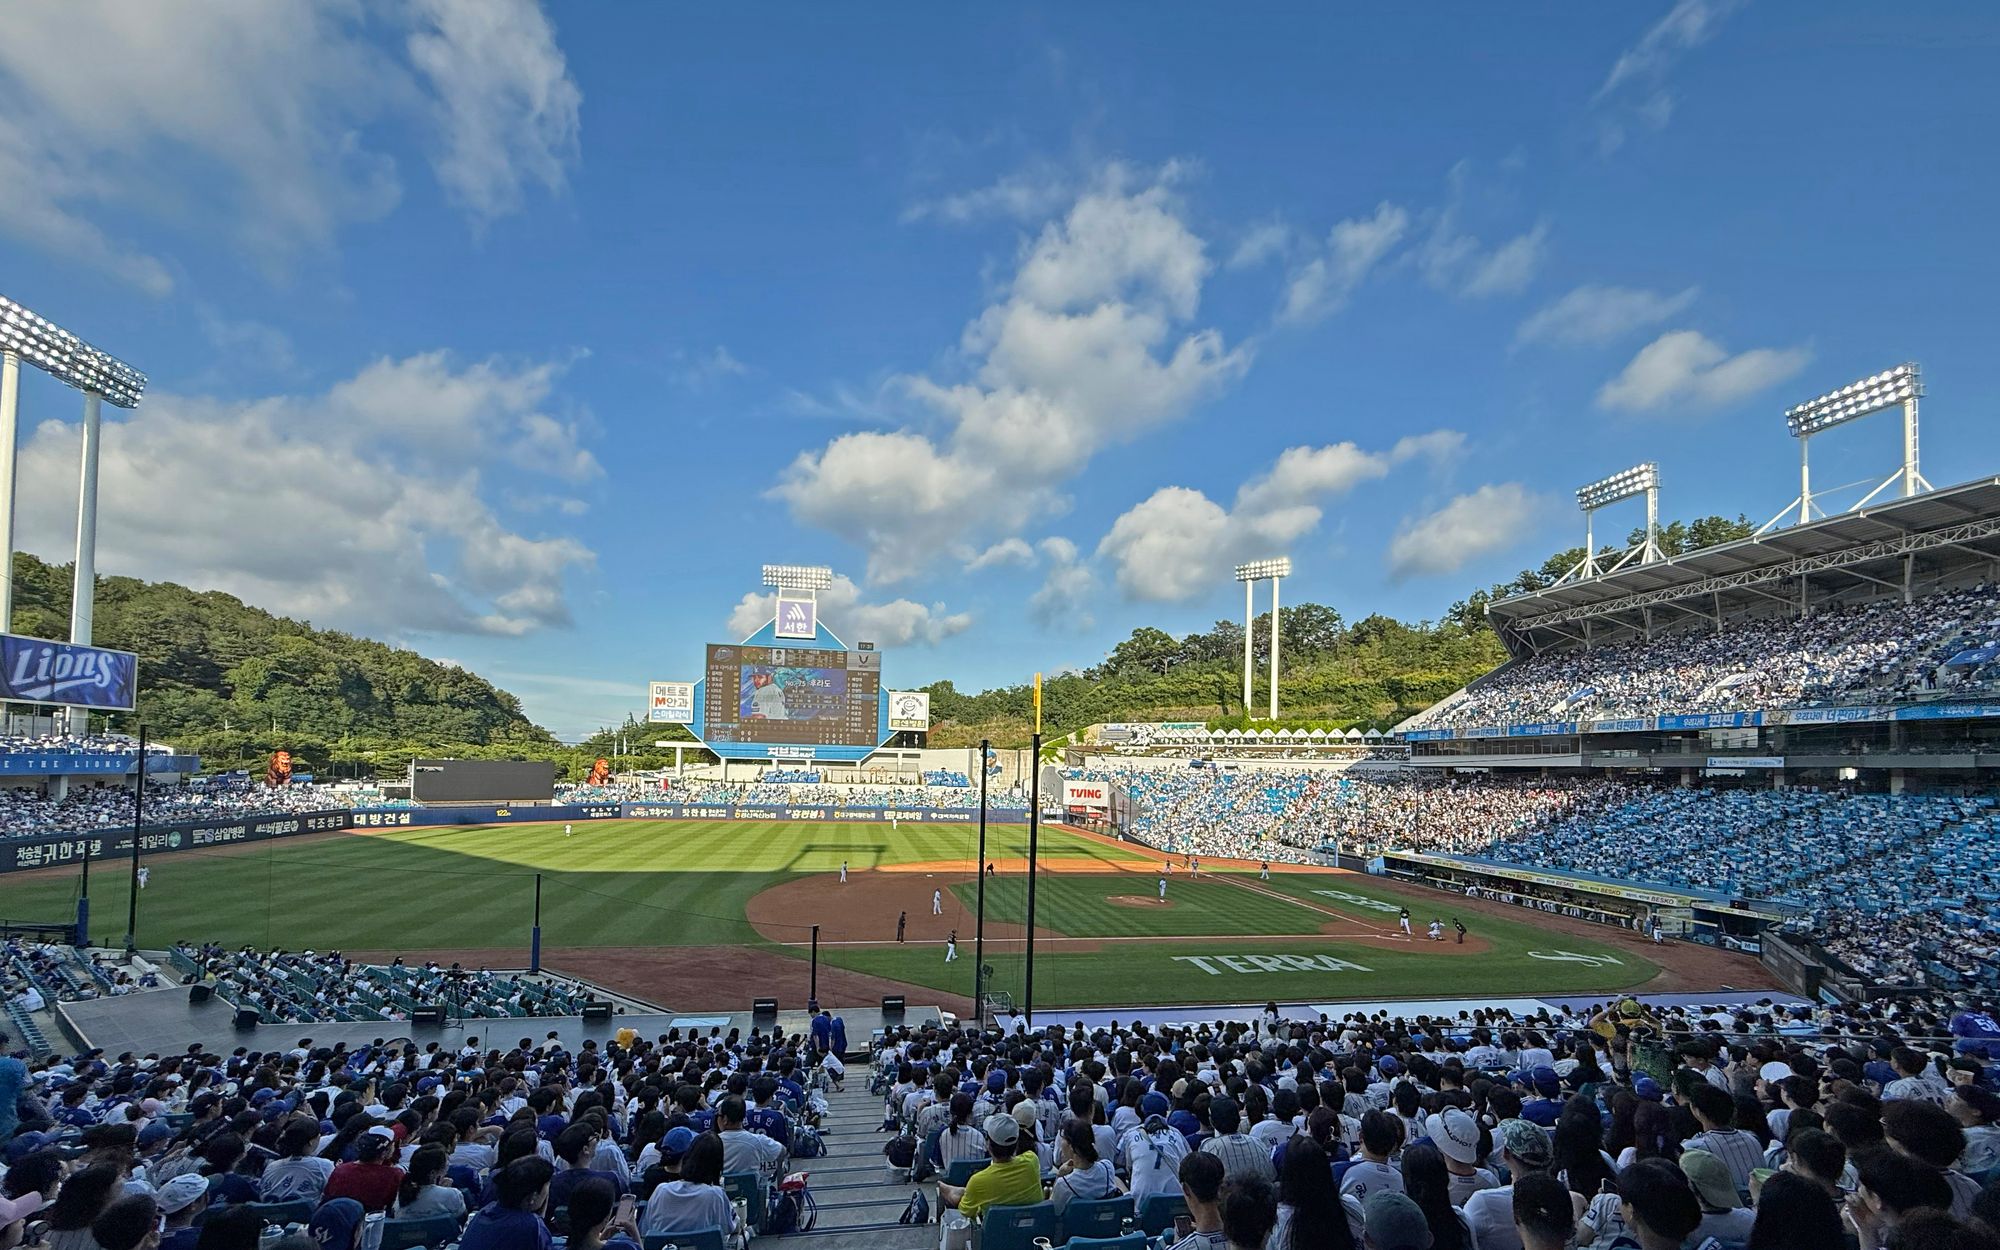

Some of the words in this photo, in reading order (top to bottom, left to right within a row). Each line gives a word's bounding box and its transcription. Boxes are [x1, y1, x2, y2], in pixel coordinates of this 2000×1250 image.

[784, 622, 807, 632] 서한
[9, 648, 114, 688] Lions
[810, 679, 831, 688] 후라도
[655, 686, 689, 696] 메트로
[653, 710, 689, 719] 스마일라식
[28, 760, 58, 768] THE
[74, 760, 121, 768] LIONS
[1070, 788, 1102, 799] TVING
[307, 816, 344, 830] 백조씽크
[353, 813, 411, 825] 대방건설
[214, 825, 246, 841] 삼일병원
[1555, 880, 1575, 888] BESKO
[1600, 887, 1621, 896] BESKO
[1651, 896, 1675, 905] BESKO
[1171, 954, 1375, 975] TERRA
